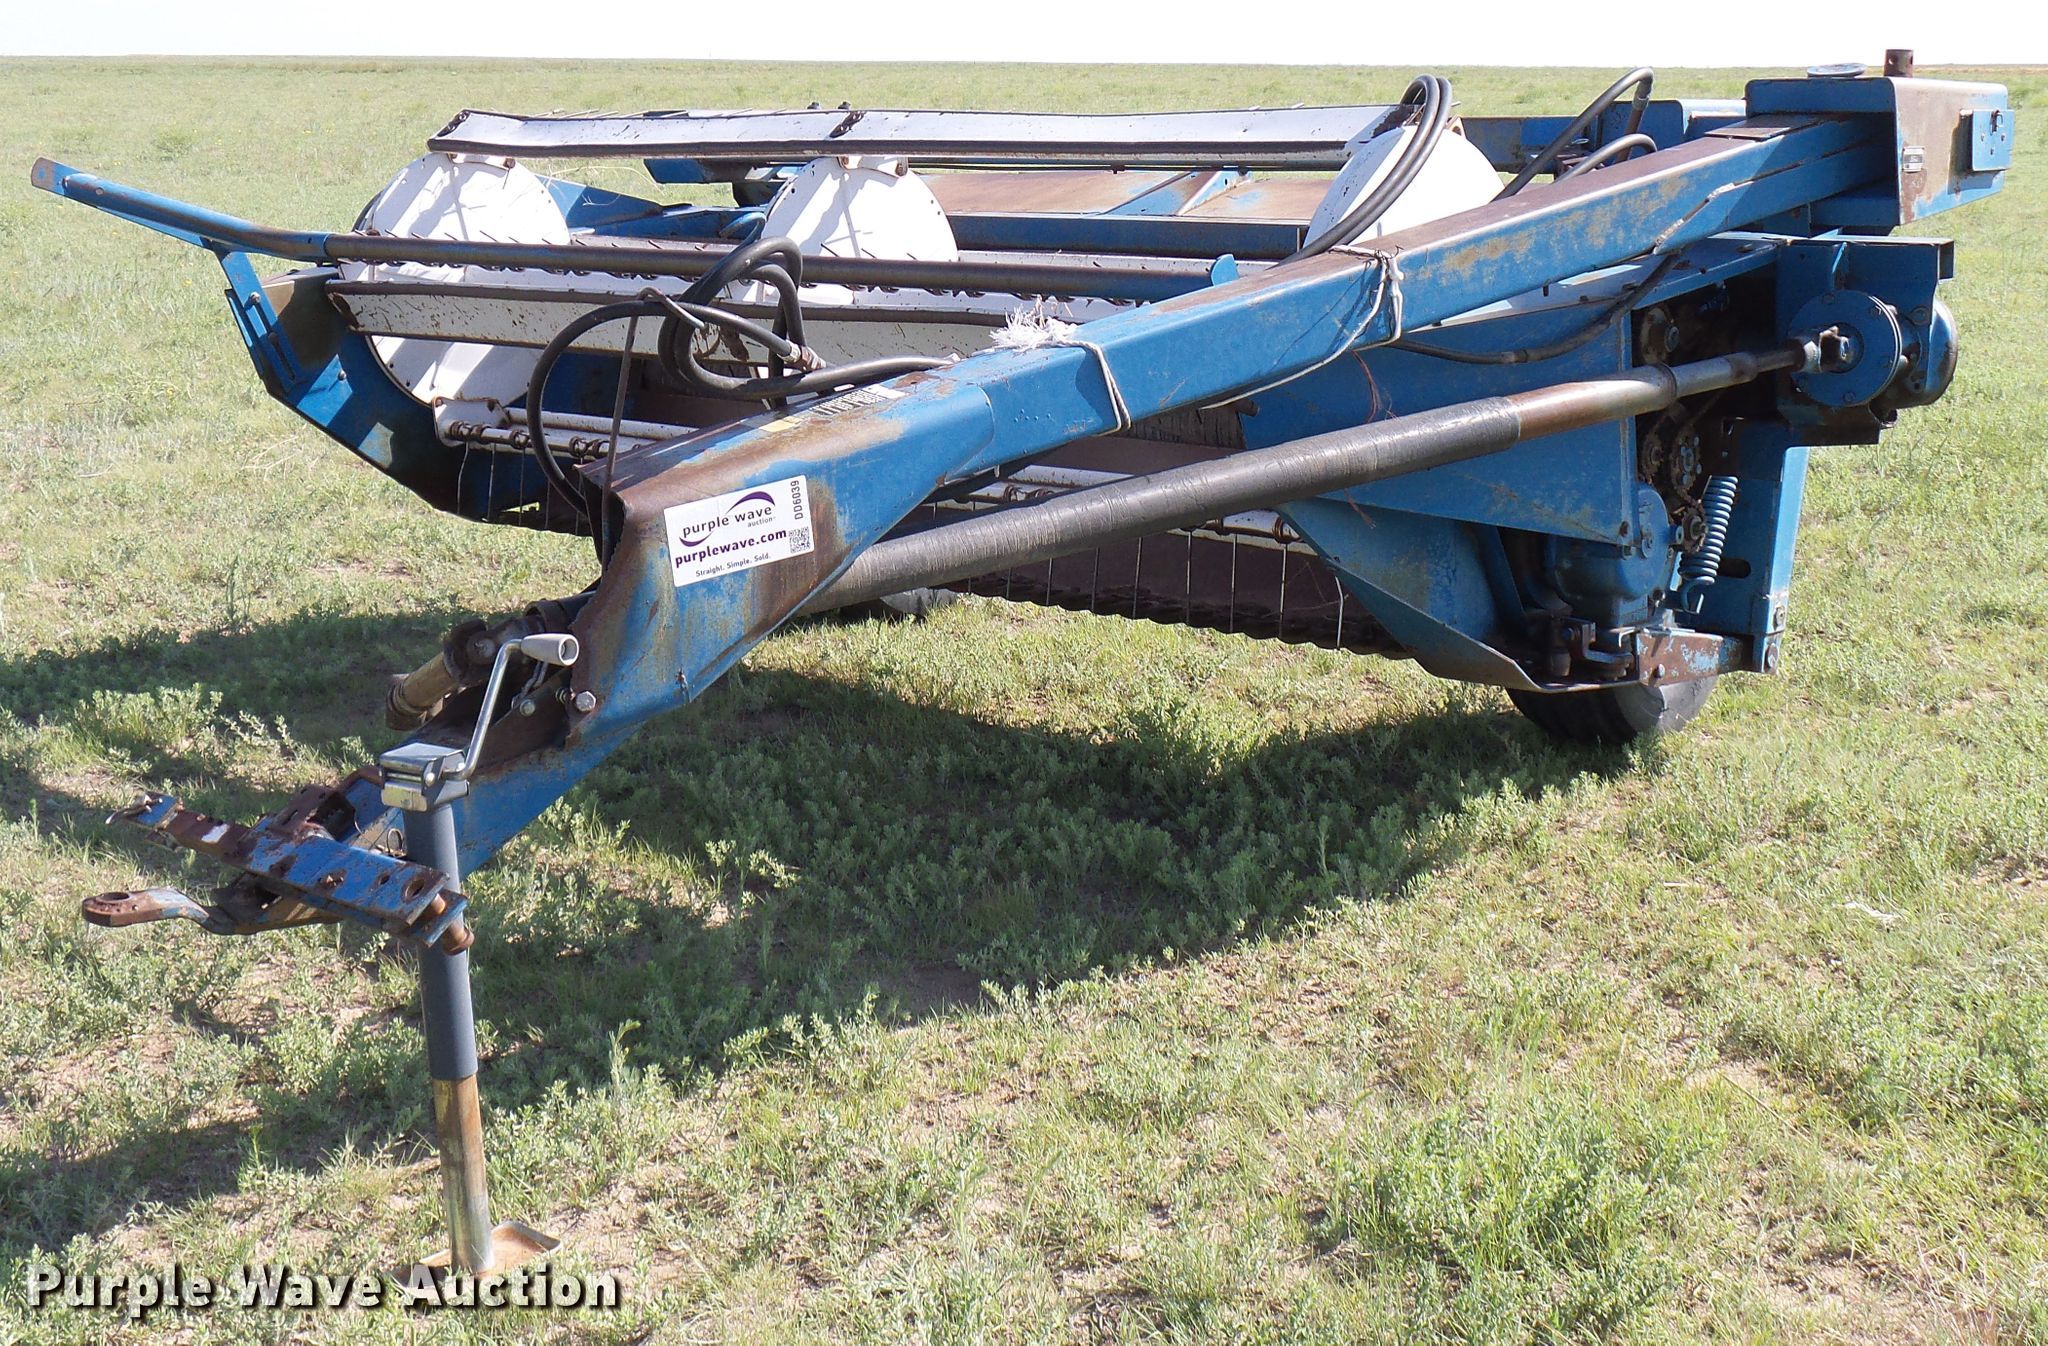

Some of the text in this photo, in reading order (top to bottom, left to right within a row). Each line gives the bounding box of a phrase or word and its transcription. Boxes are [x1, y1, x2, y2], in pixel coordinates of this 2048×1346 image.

[790, 480, 804, 520] DD6039
[682, 506, 772, 538] purple wave
[675, 530, 787, 568] purplewave.com
[696, 553, 771, 577] Straight. Simple. Sold.
